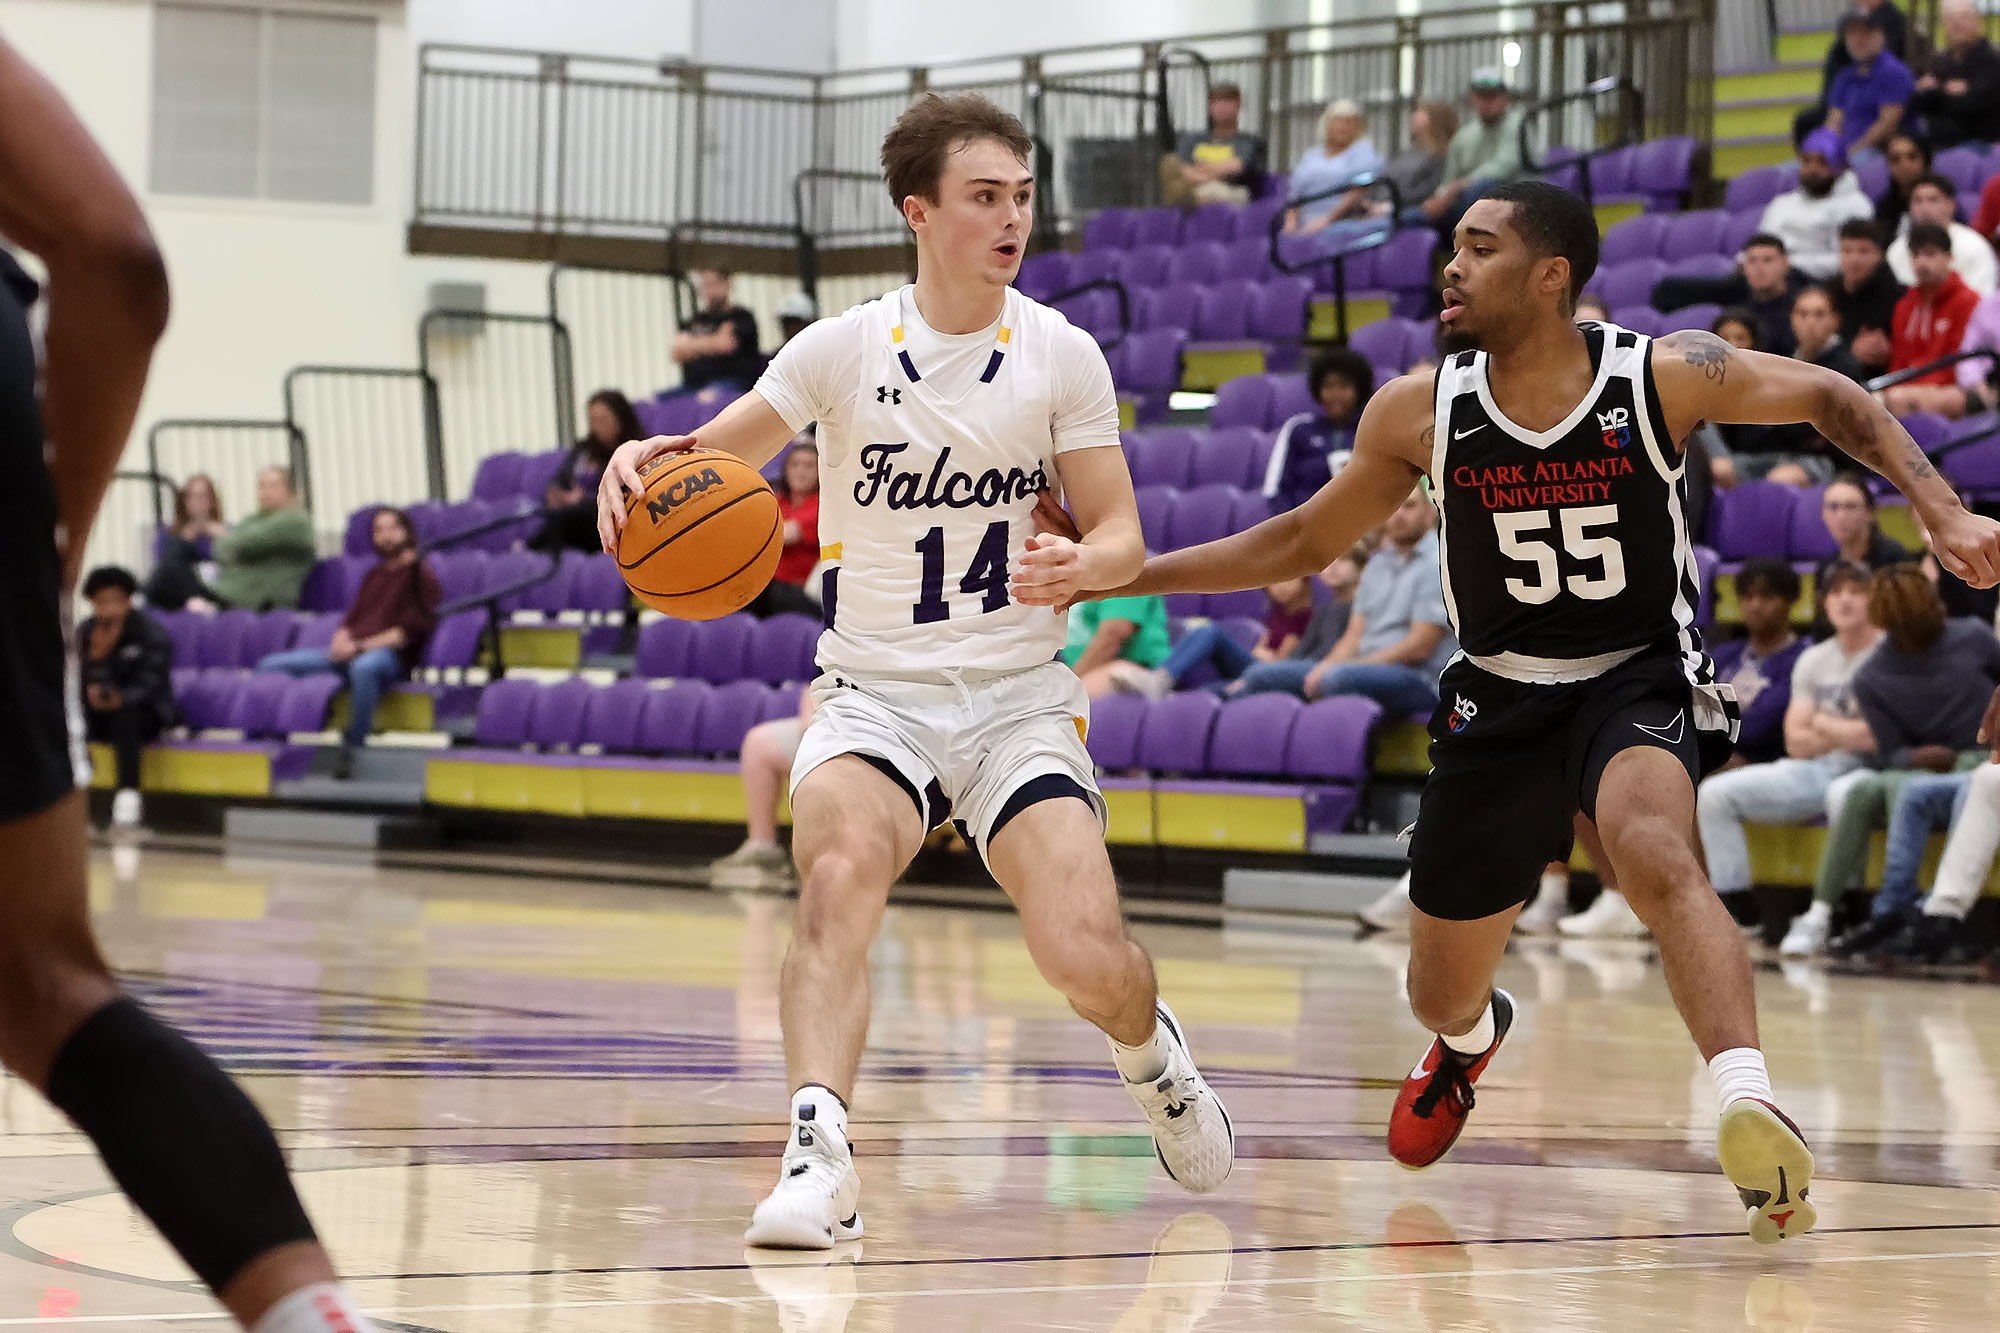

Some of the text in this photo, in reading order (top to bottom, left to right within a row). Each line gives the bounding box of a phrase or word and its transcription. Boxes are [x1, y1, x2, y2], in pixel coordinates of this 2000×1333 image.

[646, 467, 725, 525] NCAA
[1453, 456, 1635, 488] CLARK ATLANTA
[1479, 481, 1612, 510] UNIVERSITY
[912, 520, 1011, 625] 14
[1493, 503, 1627, 605] 55
